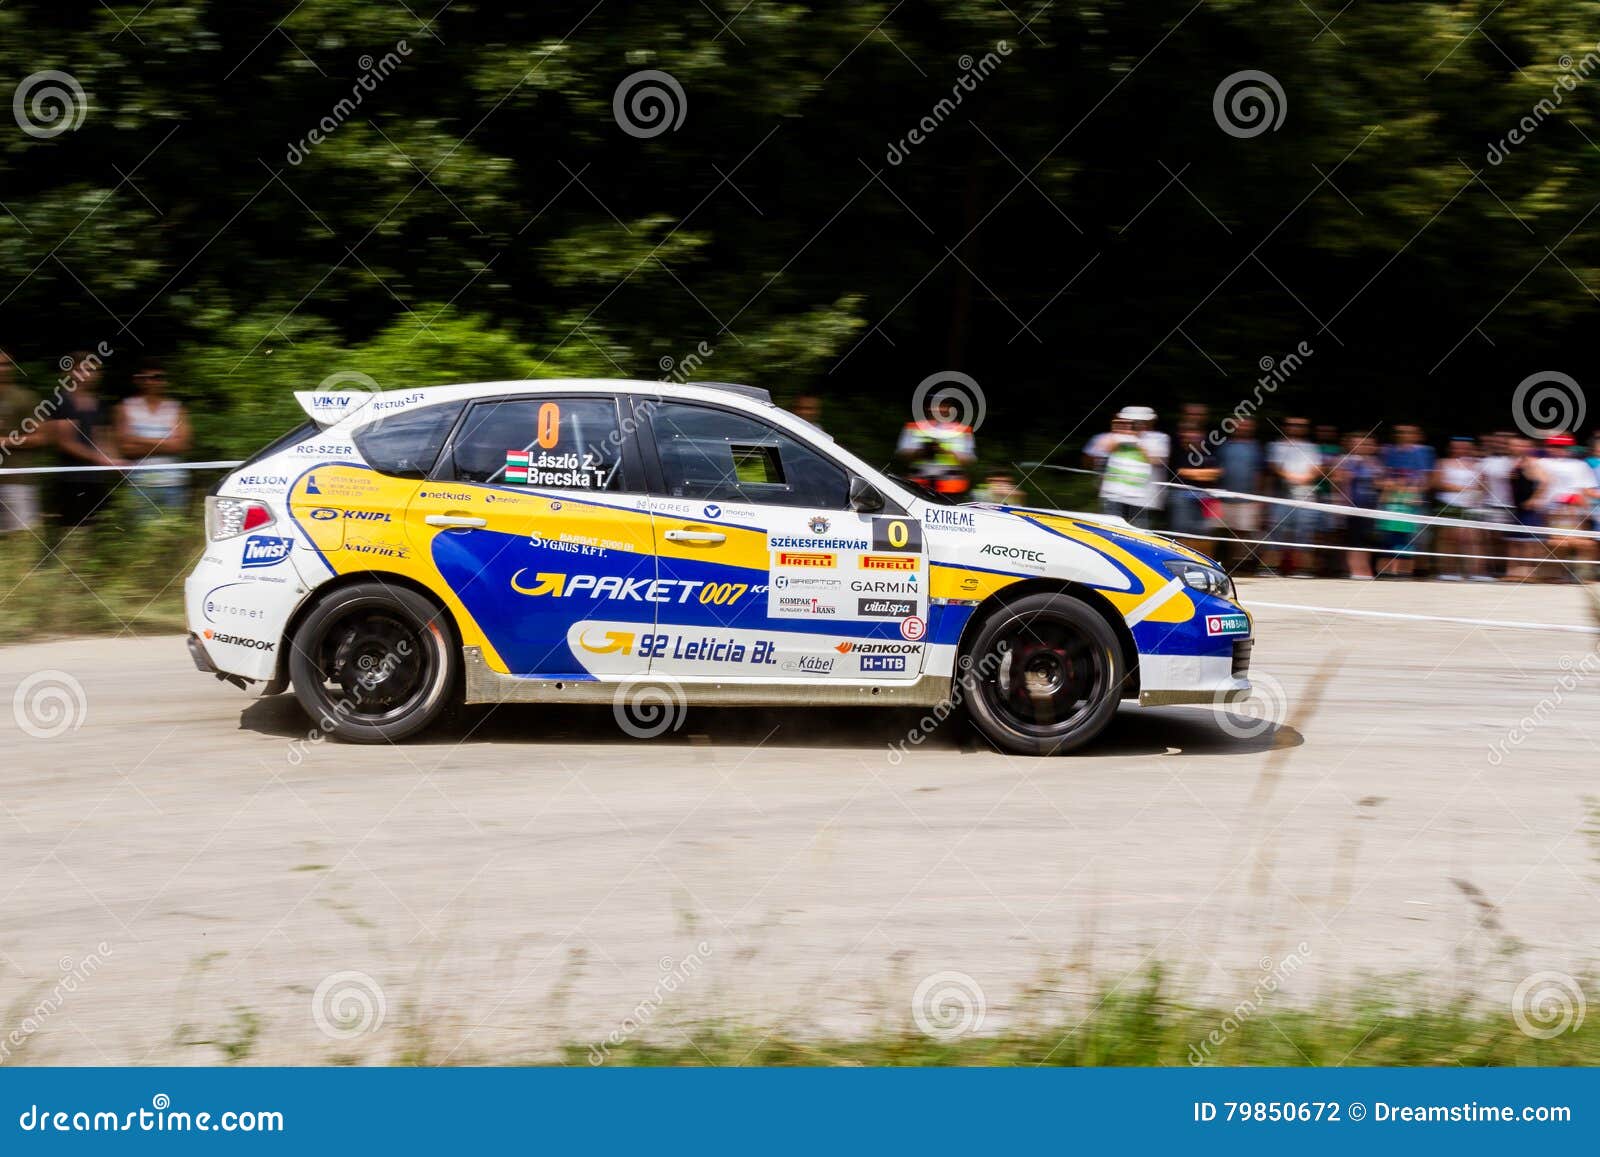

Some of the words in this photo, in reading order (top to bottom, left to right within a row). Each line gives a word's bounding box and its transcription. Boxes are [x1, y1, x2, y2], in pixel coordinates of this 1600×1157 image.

[537, 402, 560, 449] 0
[296, 445, 352, 455] RG-SZER
[528, 451, 578, 470] László
[581, 454, 596, 471] Z.
[239, 475, 288, 485] NELSON
[527, 468, 590, 487] Brecska
[594, 470, 608, 487] T.
[427, 491, 472, 501] netkids
[650, 503, 690, 513] NOREG
[343, 510, 392, 522] KNIPL
[925, 508, 975, 526] EXTREME
[888, 521, 909, 547] 0
[529, 531, 579, 553] SYGNUS
[581, 545, 608, 558] KFT.
[770, 536, 868, 550] SZÉKESFEHÉRVÁR
[247, 541, 286, 560] Twist
[980, 544, 1047, 563] AGROTEC
[780, 553, 832, 567] PIRELLI
[864, 556, 915, 570] PIRELLI
[563, 576, 704, 604] PAKET
[699, 584, 748, 605] 007
[850, 580, 918, 593] GARMIN
[779, 597, 811, 605] KOMPAK
[908, 621, 917, 634] E
[1221, 619, 1236, 630] FHB
[638, 634, 668, 658] 92
[673, 635, 745, 663] Leticia
[750, 640, 777, 665] Bt.
[798, 655, 834, 671] Kábel
[863, 658, 905, 669] H-ITB
